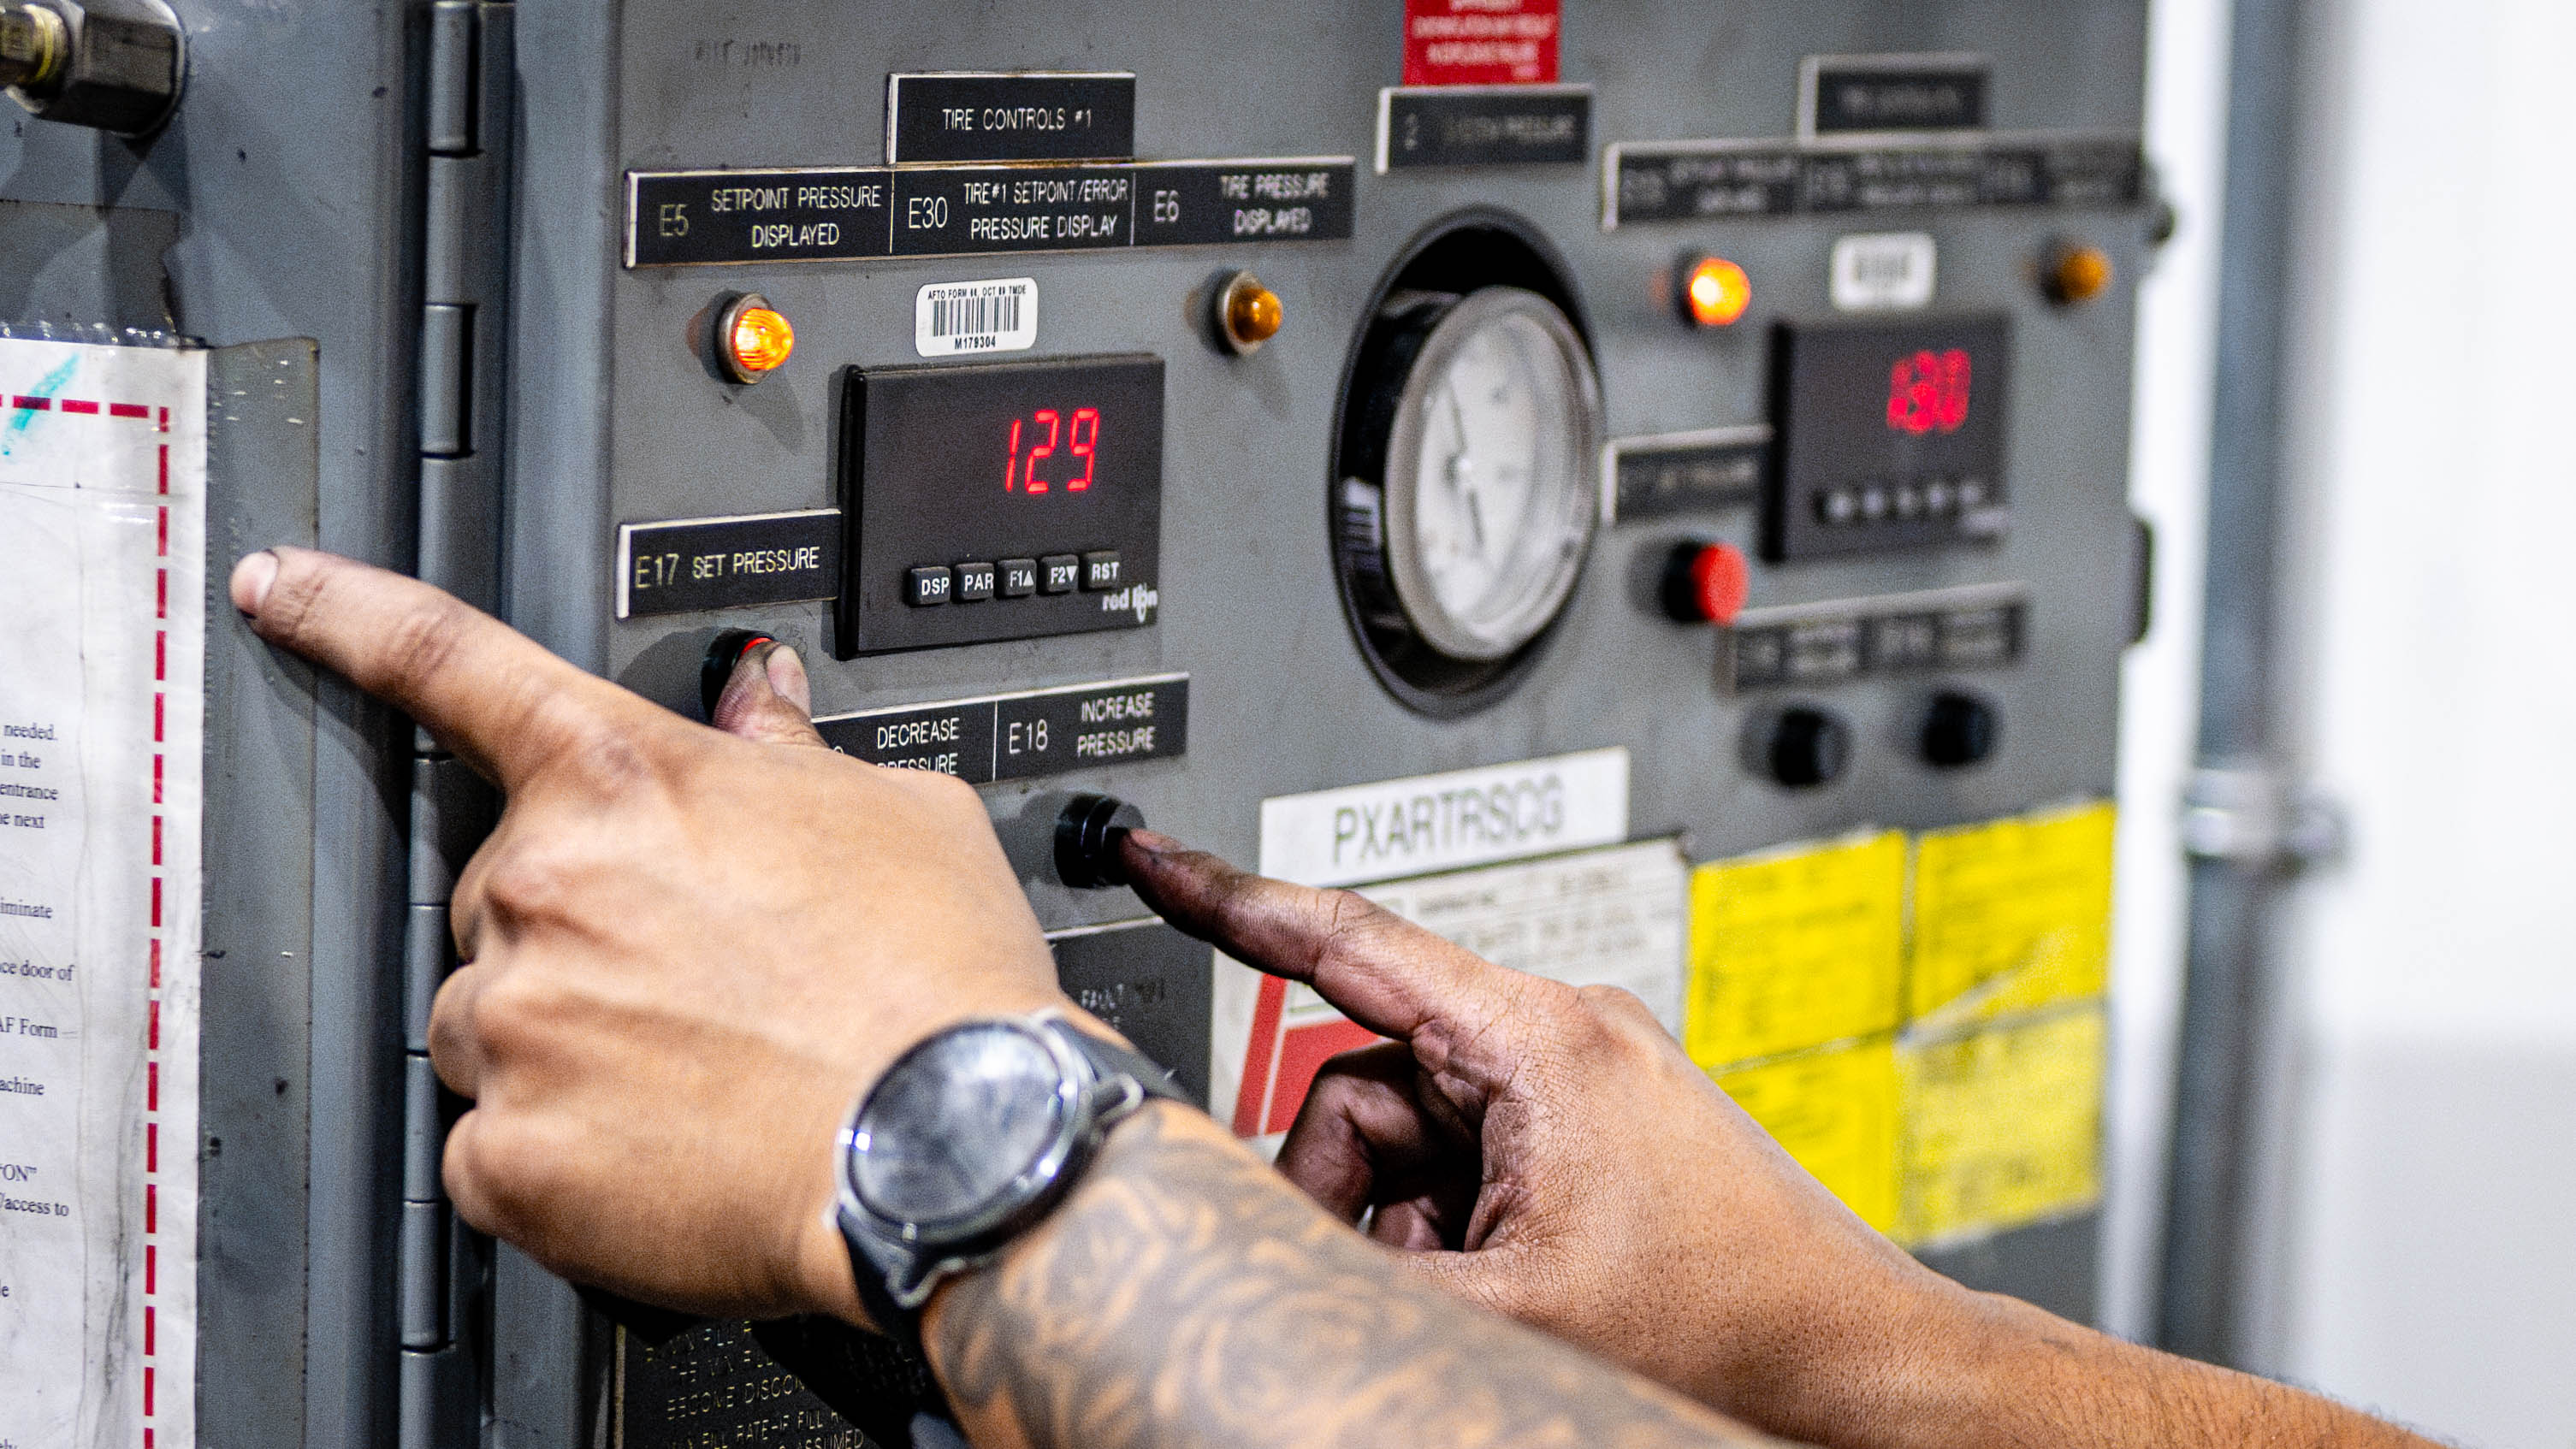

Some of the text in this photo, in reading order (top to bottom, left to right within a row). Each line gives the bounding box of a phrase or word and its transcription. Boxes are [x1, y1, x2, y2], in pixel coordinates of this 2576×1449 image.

[943, 108, 1092, 130] TIRE CONTROLS #1
[1220, 172, 1329, 199] TIRE PRESSURE
[711, 185, 882, 213] SETPOINT PRESSURE
[1154, 189, 1180, 223] E6
[659, 204, 690, 237] E5
[909, 197, 948, 228] E30
[1234, 206, 1313, 236] DISPLAYED
[752, 223, 839, 248] DISPLAYED
[970, 215, 1117, 240] PRESSURE DISPLAY
[928, 290, 945, 301] AFTO
[948, 288, 967, 299] FORM
[982, 286, 996, 297] OCT
[954, 335, 996, 350] M179304
[1005, 407, 1100, 494] 129
[635, 546, 820, 588] E17 SET PRESSURE
[1051, 566, 1066, 584] F2
[1091, 562, 1120, 581] RST
[921, 577, 950, 596] DSP
[964, 573, 994, 592] PAR
[1010, 571, 1022, 588] F1
[1102, 588, 1129, 612] red
[1081, 692, 1154, 722] INCREASE
[4, 722, 58, 741] needed.
[877, 717, 960, 749] DECREASE
[1009, 719, 1049, 755] E18
[1076, 725, 1155, 758] PRESSURE
[1, 748, 41, 768] in the
[877, 753, 958, 775] SSURE
[0, 784, 58, 800] entrance
[15, 814, 44, 829] next
[0, 960, 74, 981] ce door of
[20, 1018, 57, 1038] Form
[55, 1203, 69, 1217] to
